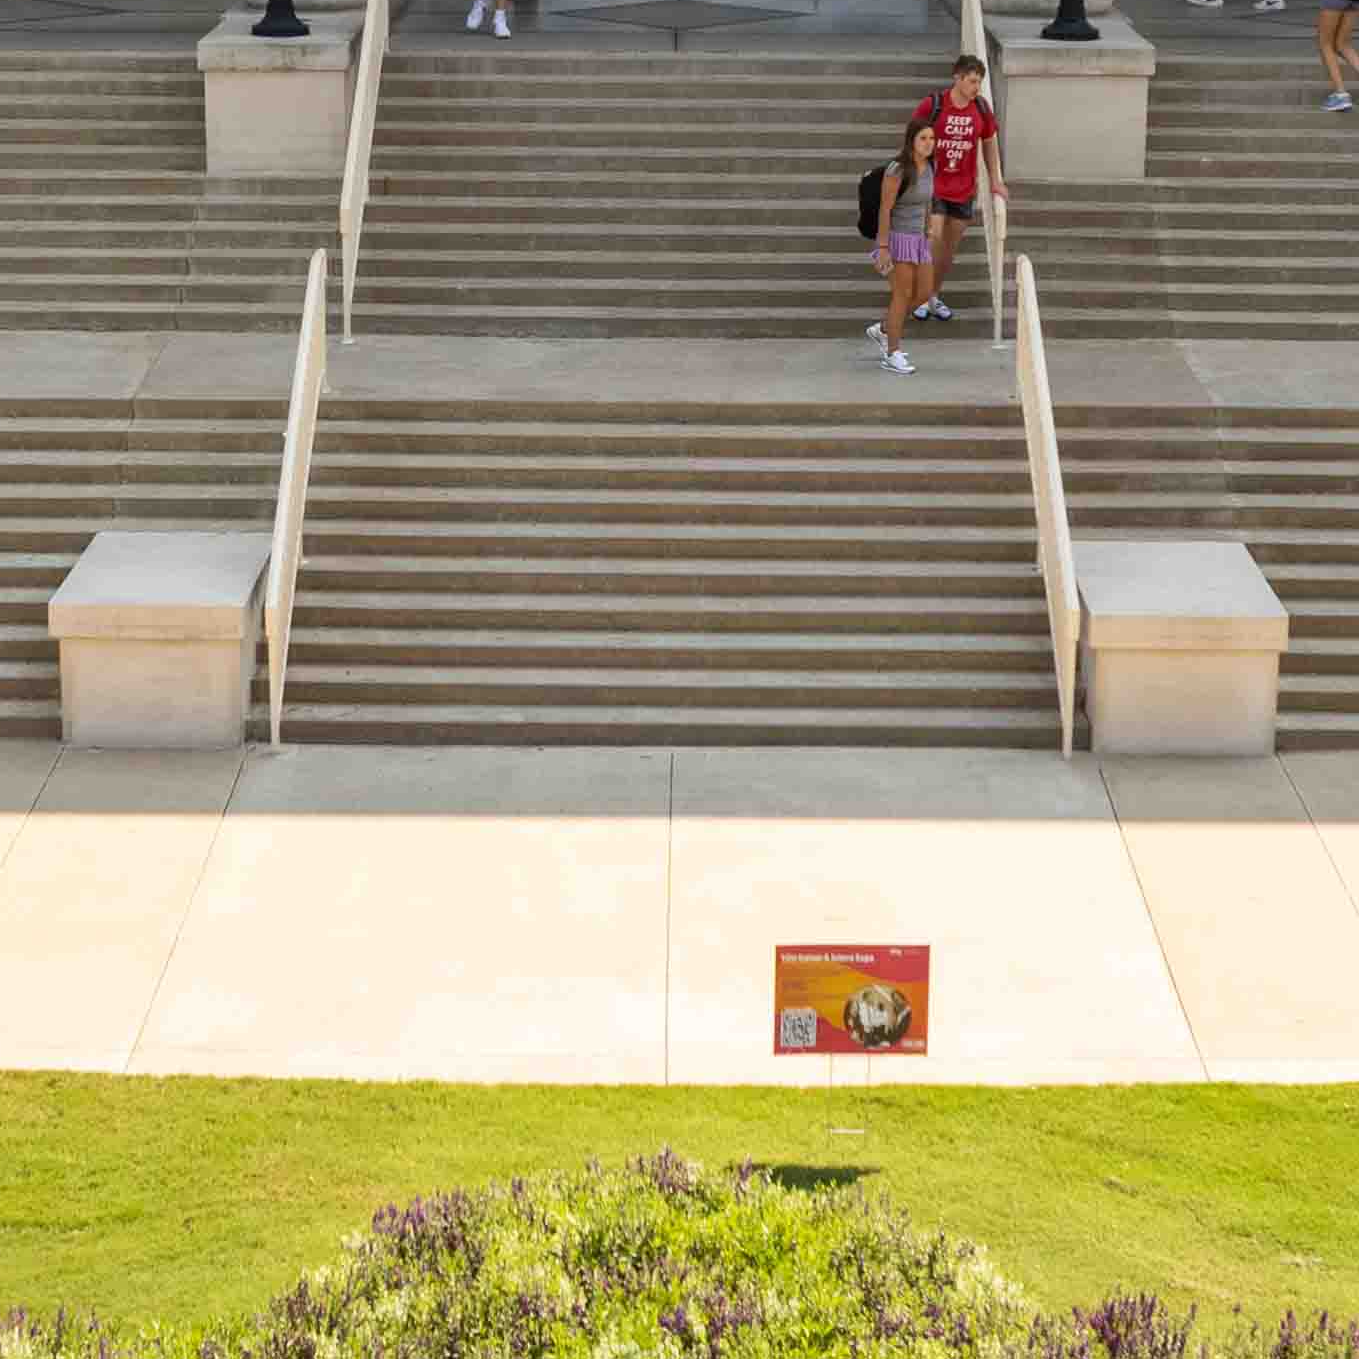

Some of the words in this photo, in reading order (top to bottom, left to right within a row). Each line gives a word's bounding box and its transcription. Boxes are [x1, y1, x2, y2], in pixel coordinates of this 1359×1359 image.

[946, 114, 973, 126] KEEP
[944, 124, 975, 137] CALM
[946, 149, 964, 160] ON
